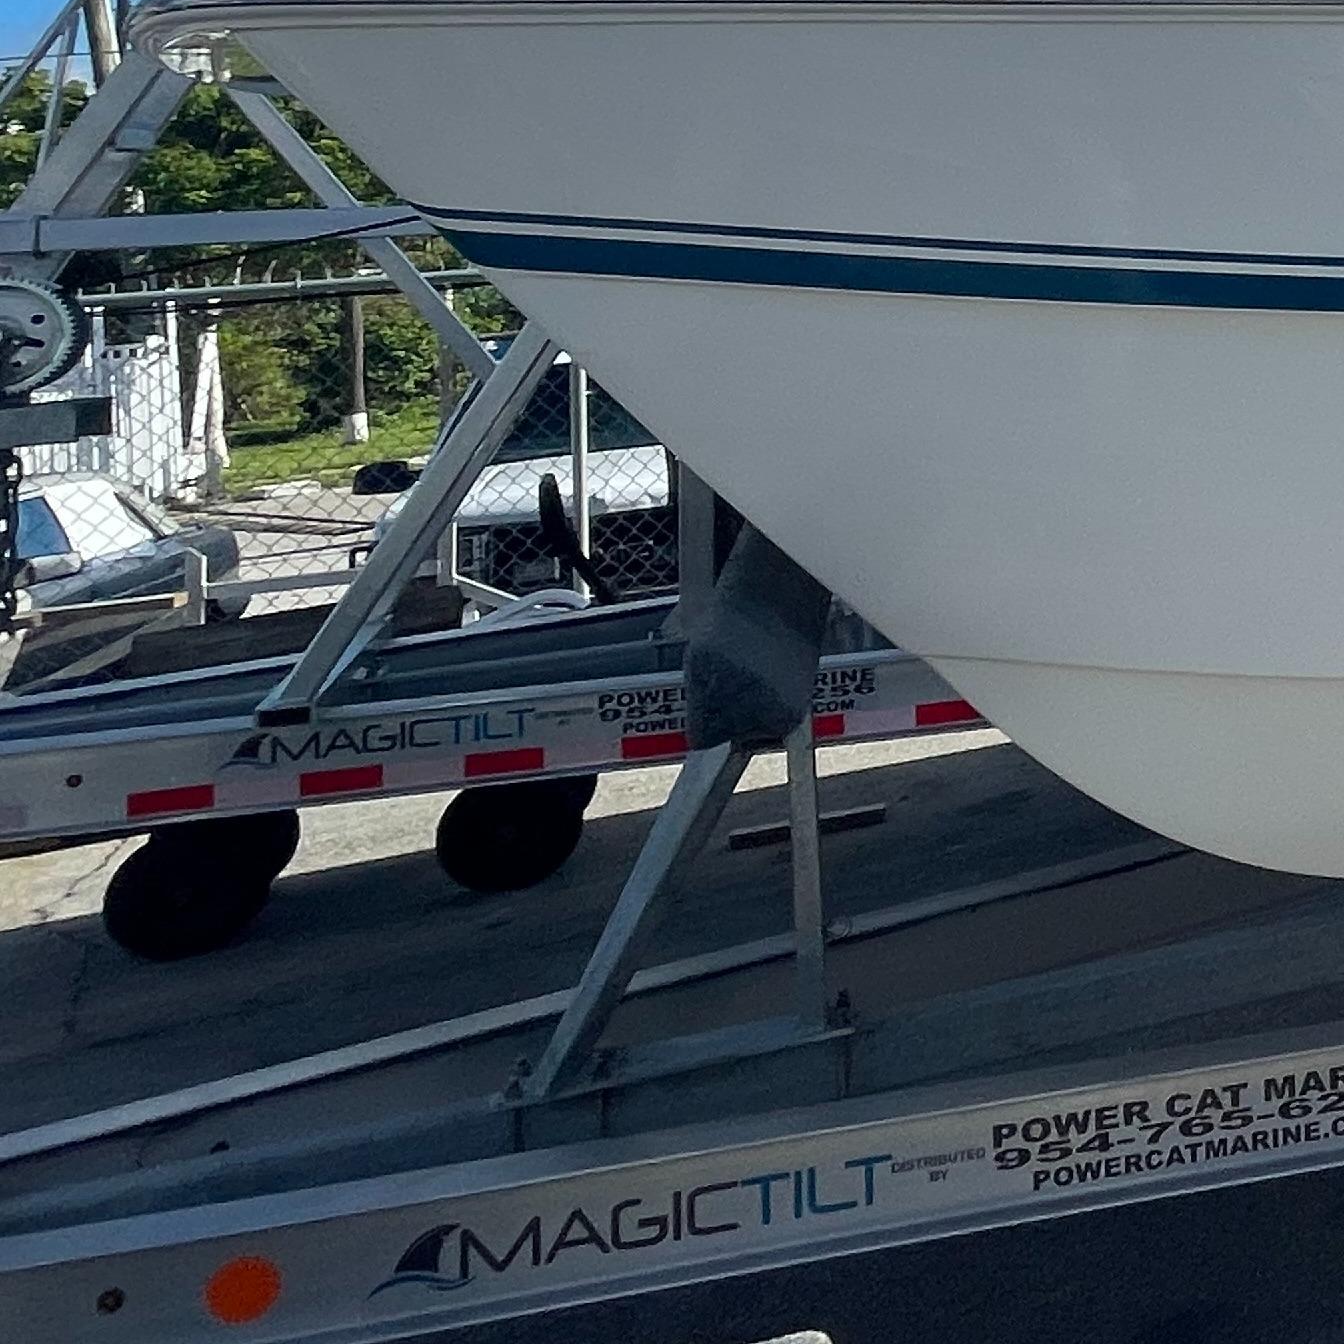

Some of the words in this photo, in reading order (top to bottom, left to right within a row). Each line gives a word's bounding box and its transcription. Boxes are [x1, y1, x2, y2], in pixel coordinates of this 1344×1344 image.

[270, 707, 536, 764] MAGICTILT
[992, 1100, 1150, 1149] POWER
[1165, 1082, 1249, 1118] CAT
[890, 1147, 986, 1174] DISTRIBUTED
[929, 1168, 949, 1183] BY
[459, 1154, 893, 1280] MAGICTILT
